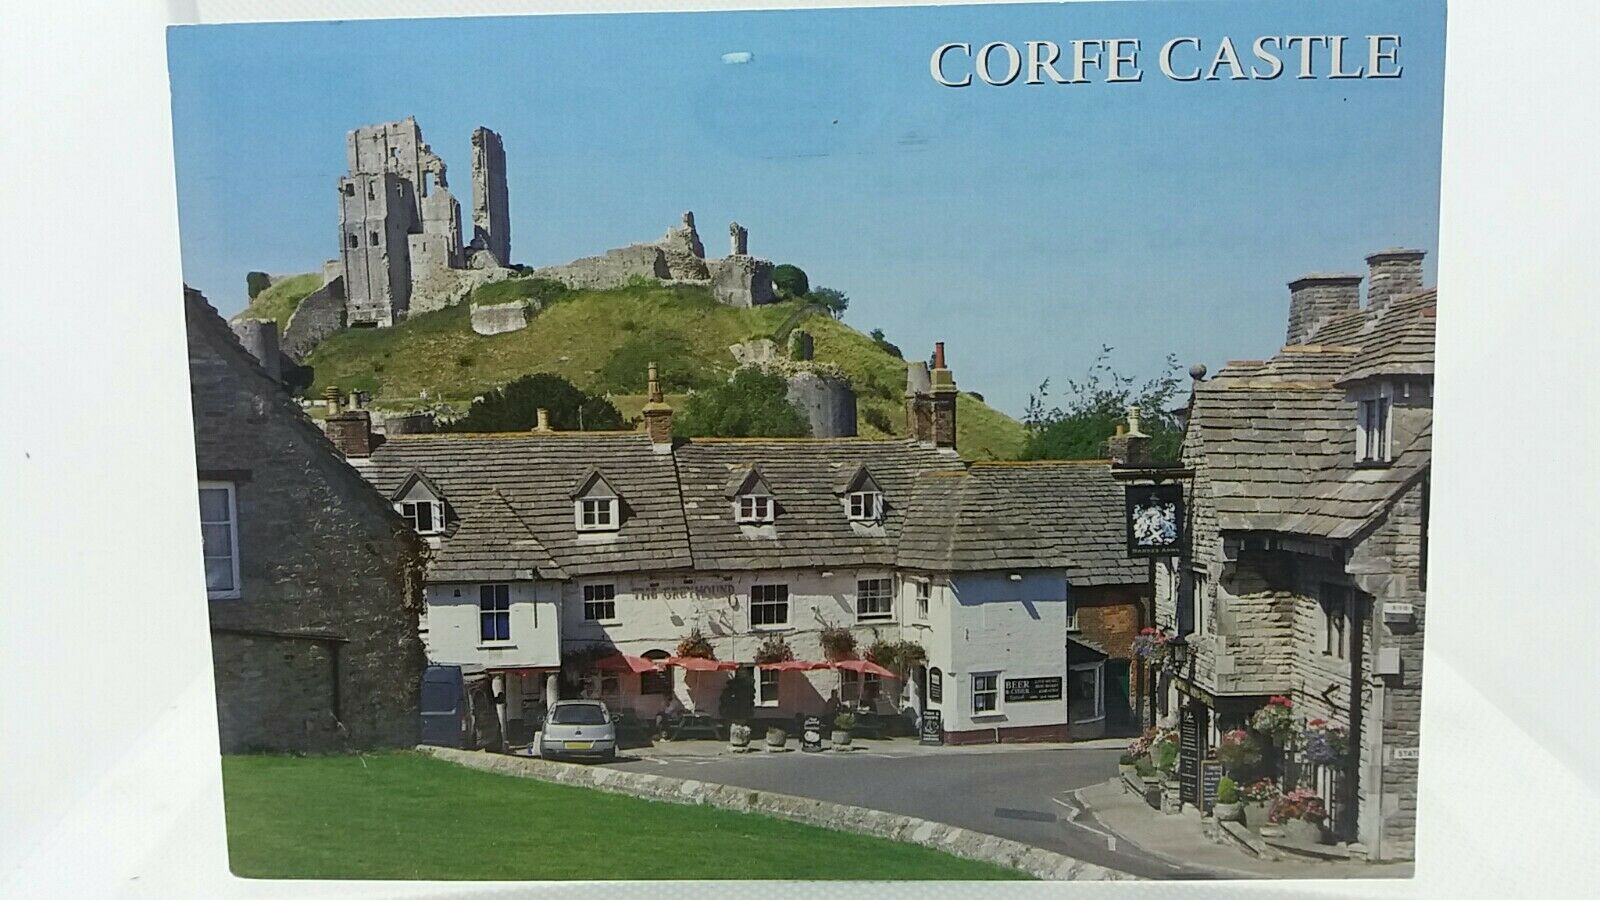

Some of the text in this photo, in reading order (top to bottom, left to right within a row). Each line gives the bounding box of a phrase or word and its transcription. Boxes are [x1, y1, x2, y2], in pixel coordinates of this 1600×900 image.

[930, 34, 1405, 87] CORFE CASTLE
[663, 584, 735, 600] GREYHOUND
[1005, 680, 1030, 689] BEER
